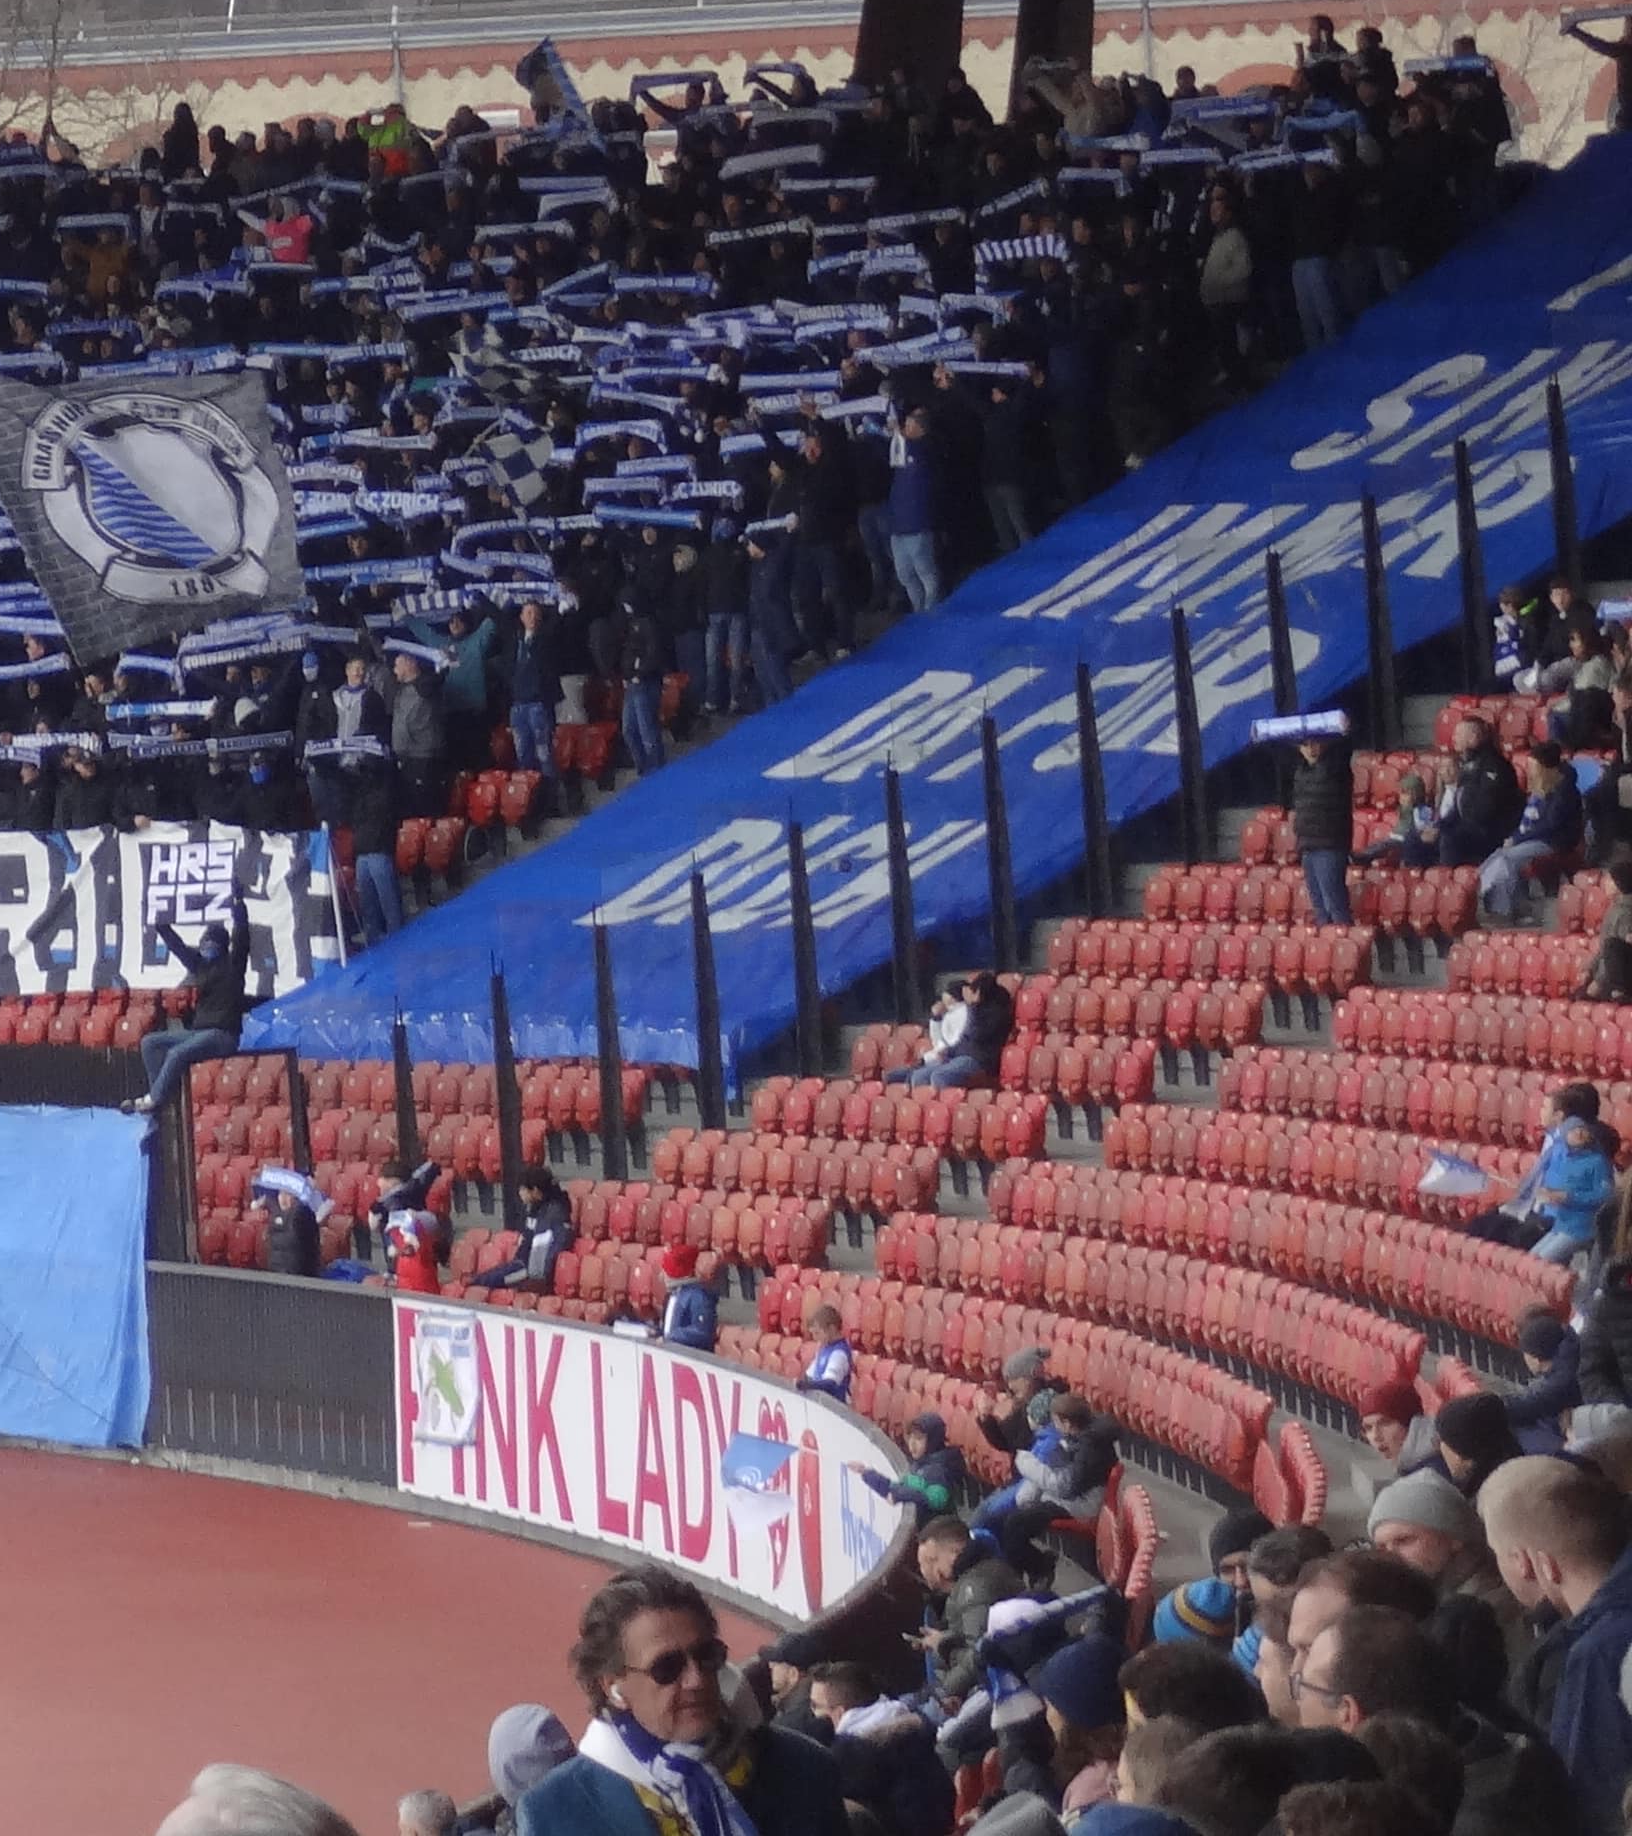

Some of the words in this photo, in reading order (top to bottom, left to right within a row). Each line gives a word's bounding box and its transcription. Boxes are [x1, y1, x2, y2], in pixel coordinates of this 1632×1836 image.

[168, 573, 228, 596] 188
[150, 841, 235, 885] HRS
[147, 882, 234, 926] FCZ
[590, 1340, 744, 1580] LADY
